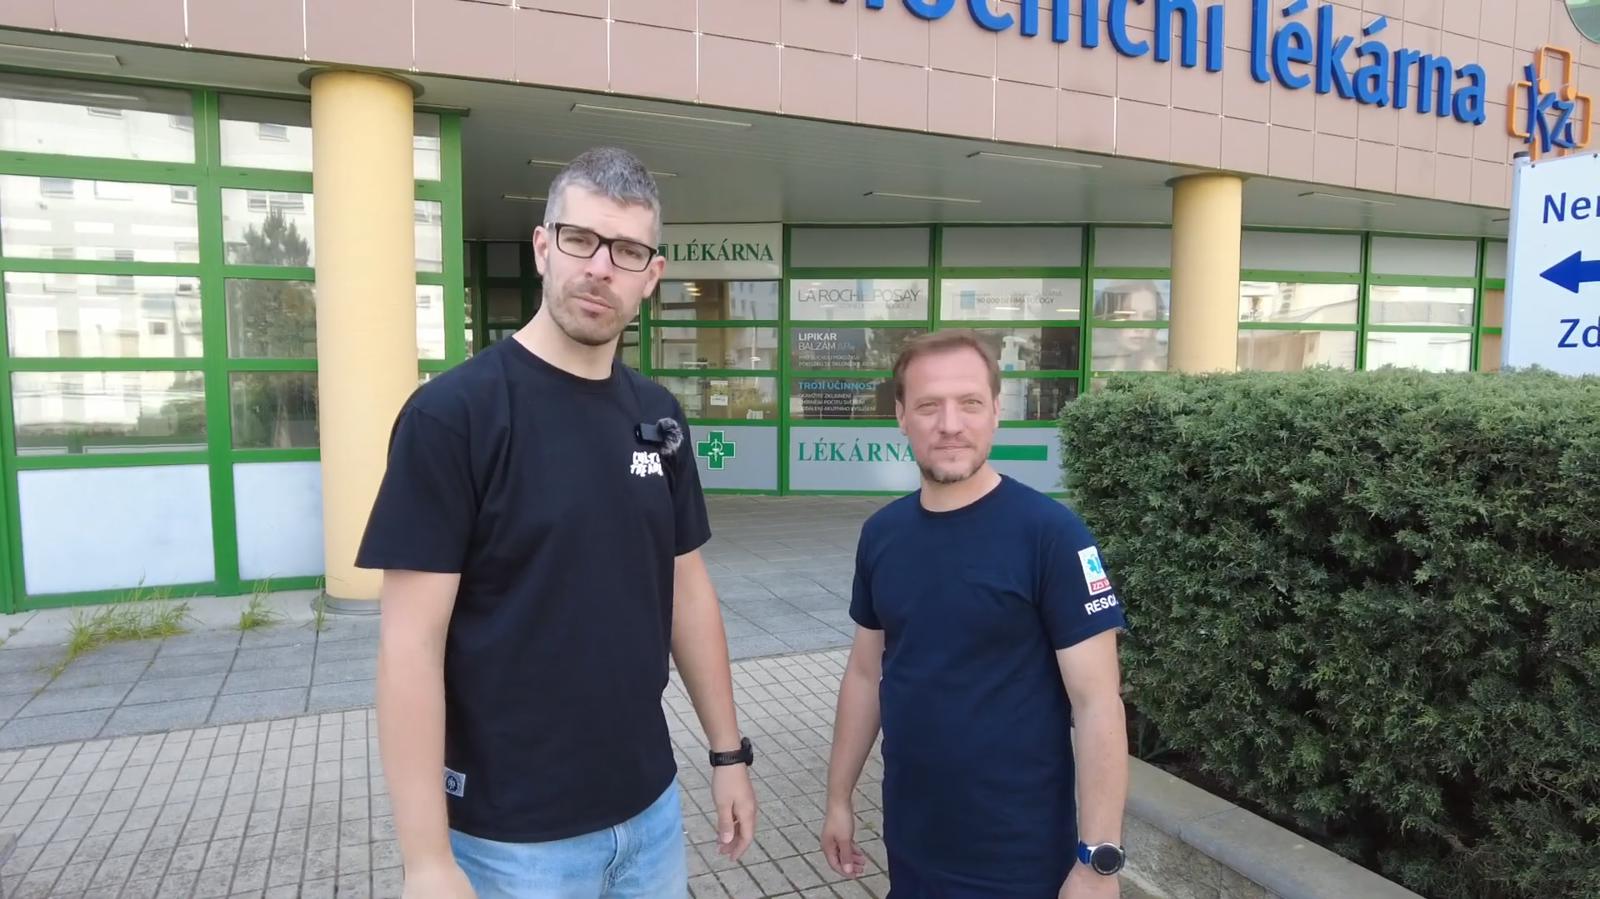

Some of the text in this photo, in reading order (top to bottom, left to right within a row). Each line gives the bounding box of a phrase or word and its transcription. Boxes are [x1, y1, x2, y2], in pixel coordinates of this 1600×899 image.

[1250, 0, 1486, 126] lékárna
[673, 238, 774, 262] LÉKÁRNA
[798, 333, 838, 341] LIPIKAR
[798, 438, 916, 462] LÉKÁRNA
